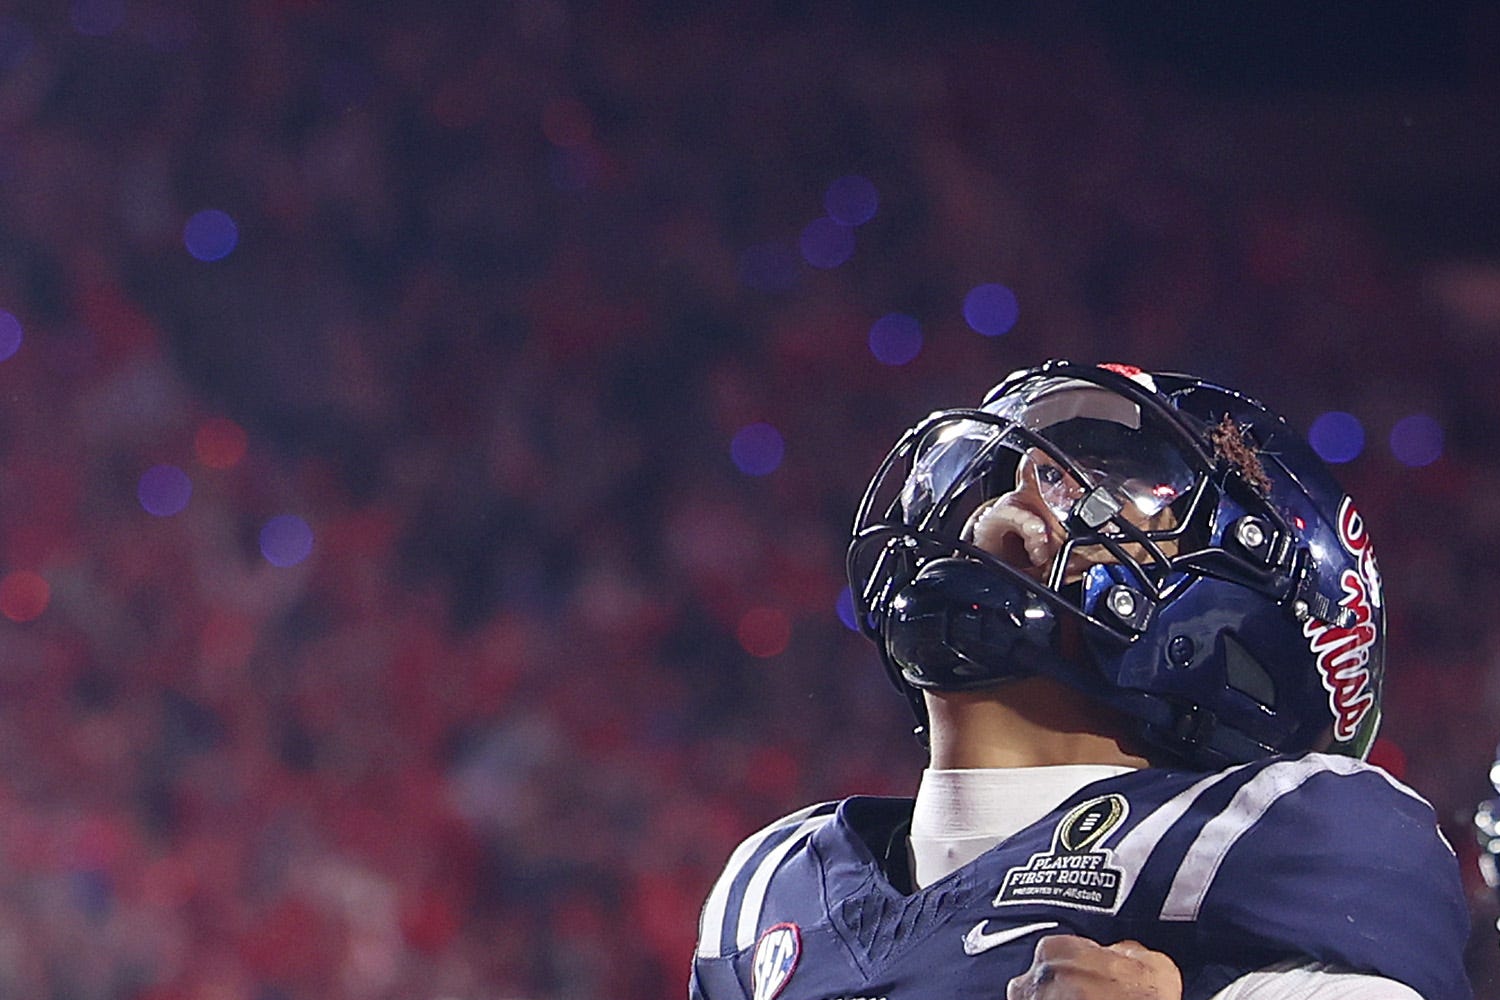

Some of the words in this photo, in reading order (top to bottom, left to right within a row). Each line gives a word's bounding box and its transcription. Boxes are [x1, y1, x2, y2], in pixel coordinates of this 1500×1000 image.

[1032, 855, 1102, 871] PLAYOFF
[1009, 870, 1057, 887] FIRST
[1057, 869, 1117, 888] ROUND
[1062, 887, 1103, 902] Allstate
